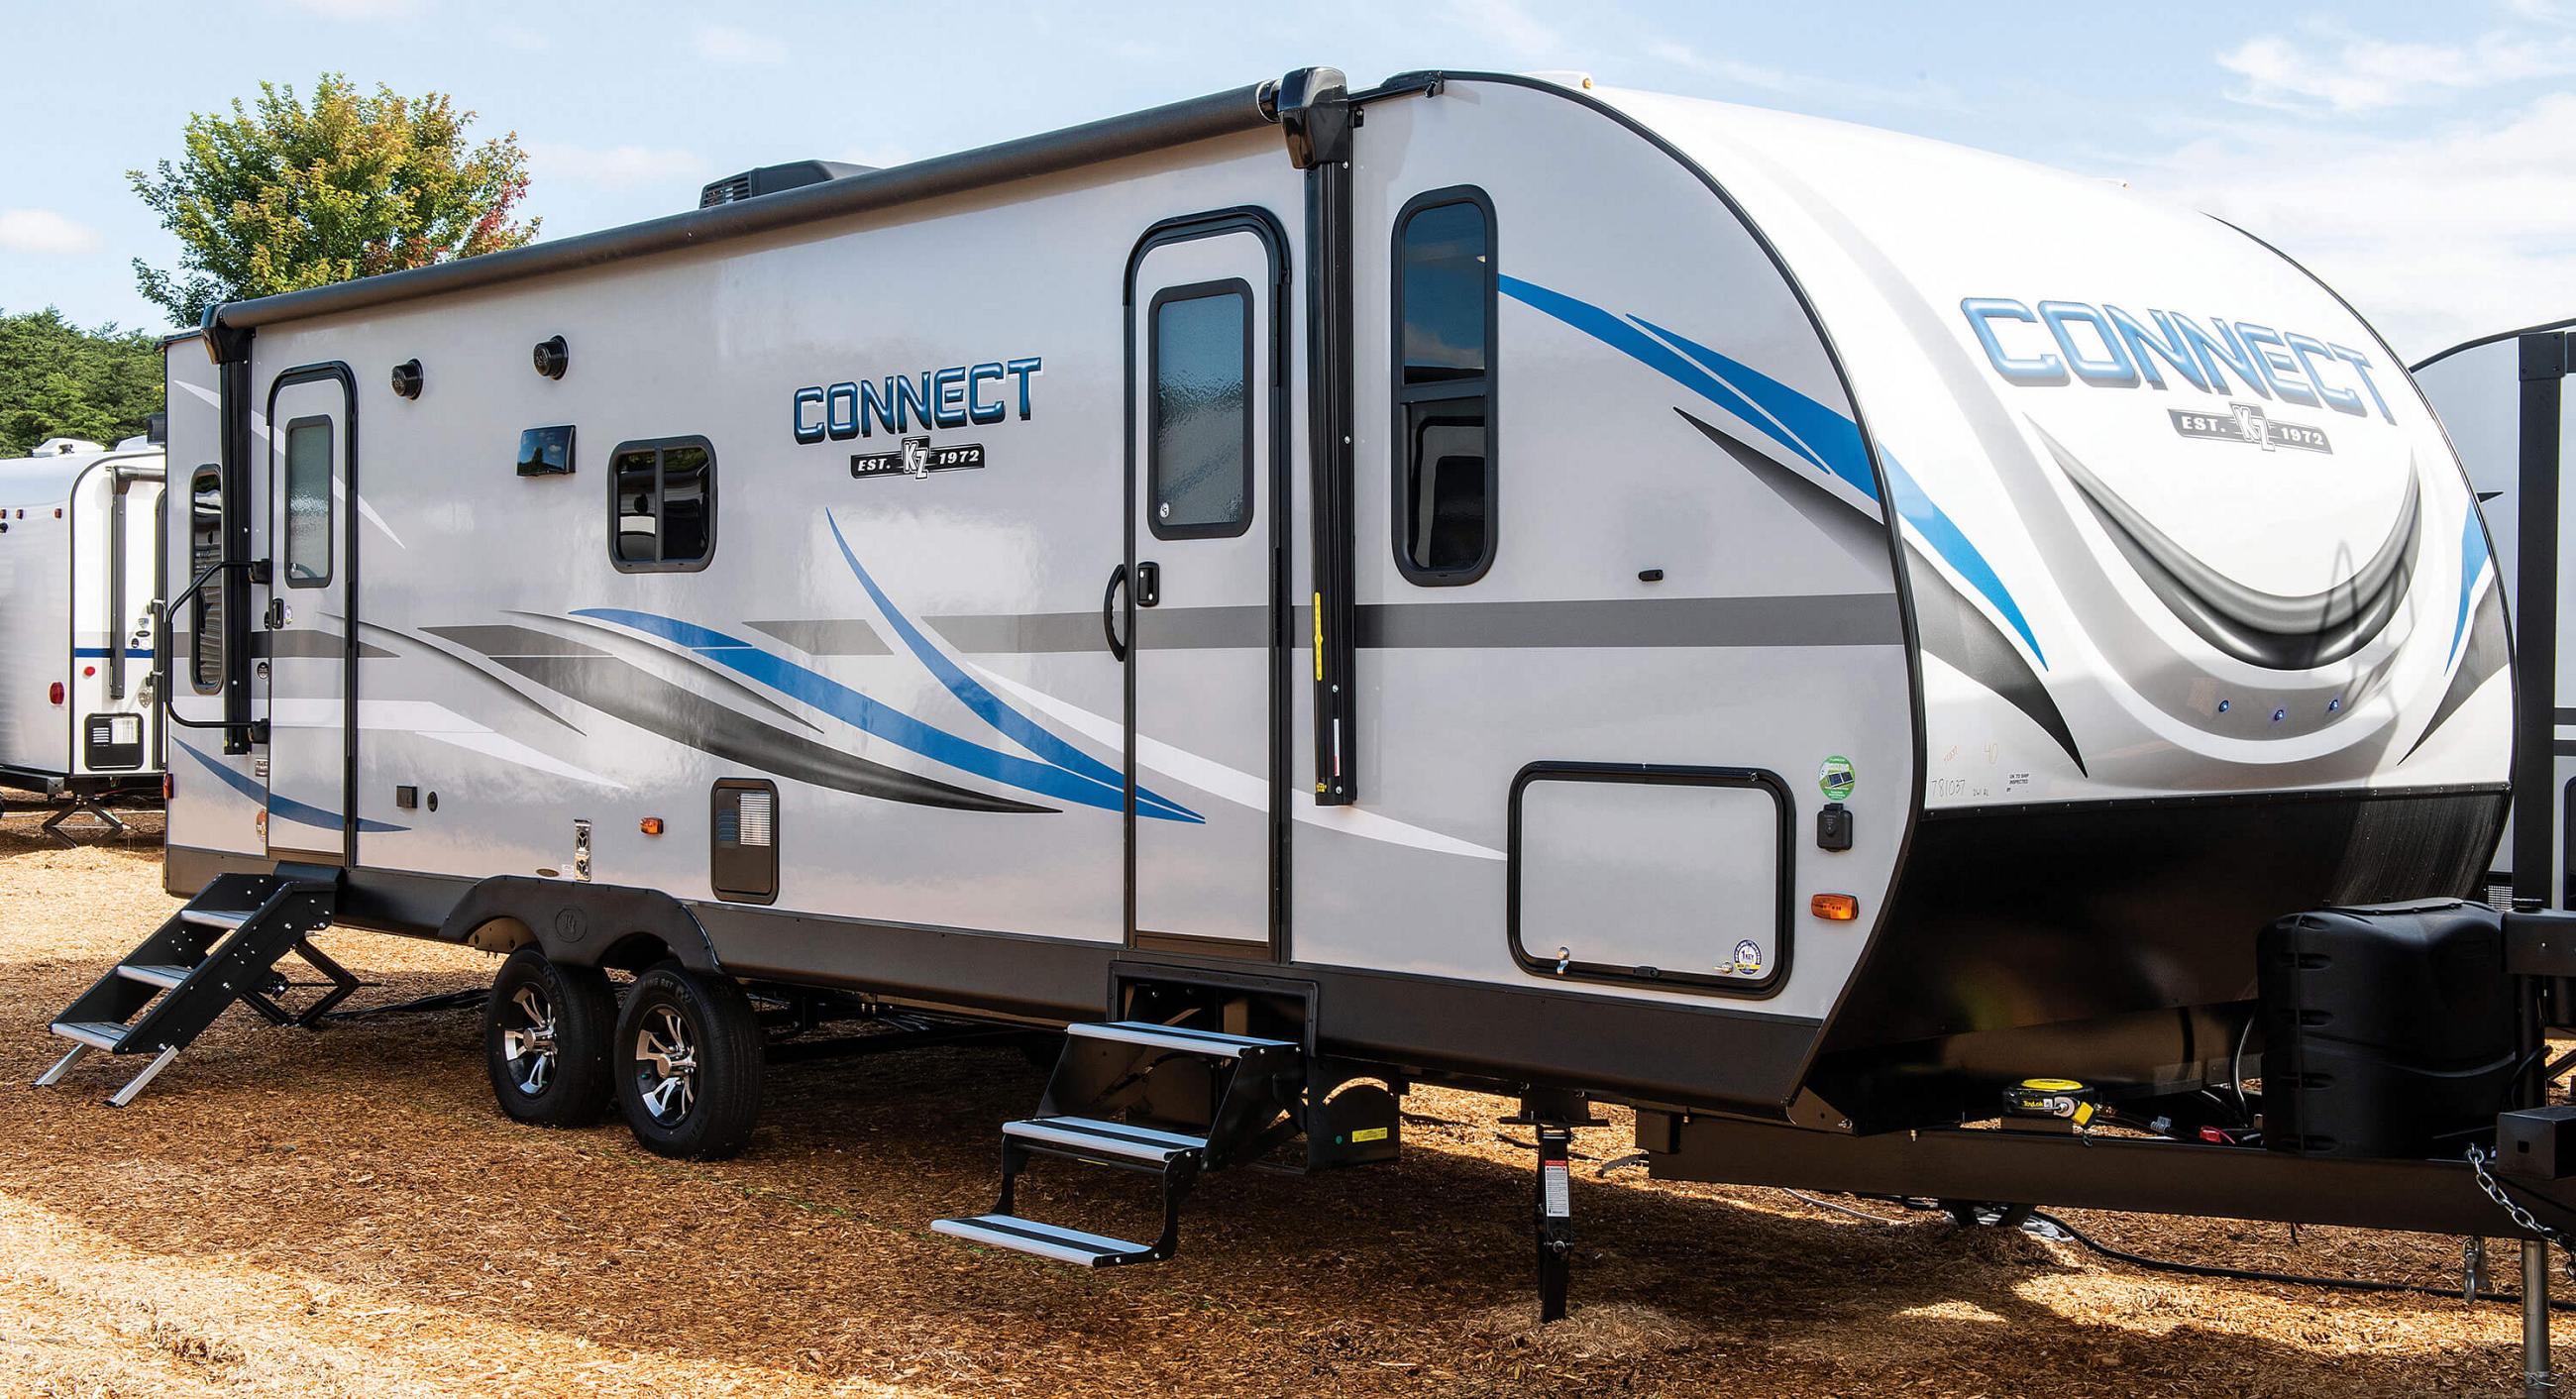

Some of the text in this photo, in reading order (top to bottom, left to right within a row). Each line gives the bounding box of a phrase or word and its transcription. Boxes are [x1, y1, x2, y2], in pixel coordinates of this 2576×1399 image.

[1960, 296, 2398, 426] CONNECT
[793, 356, 1042, 445] CONNECT
[2180, 415, 2227, 434] EST.
[2281, 426, 2325, 446] 1972
[857, 440, 980, 480] EST. KZ 1972
